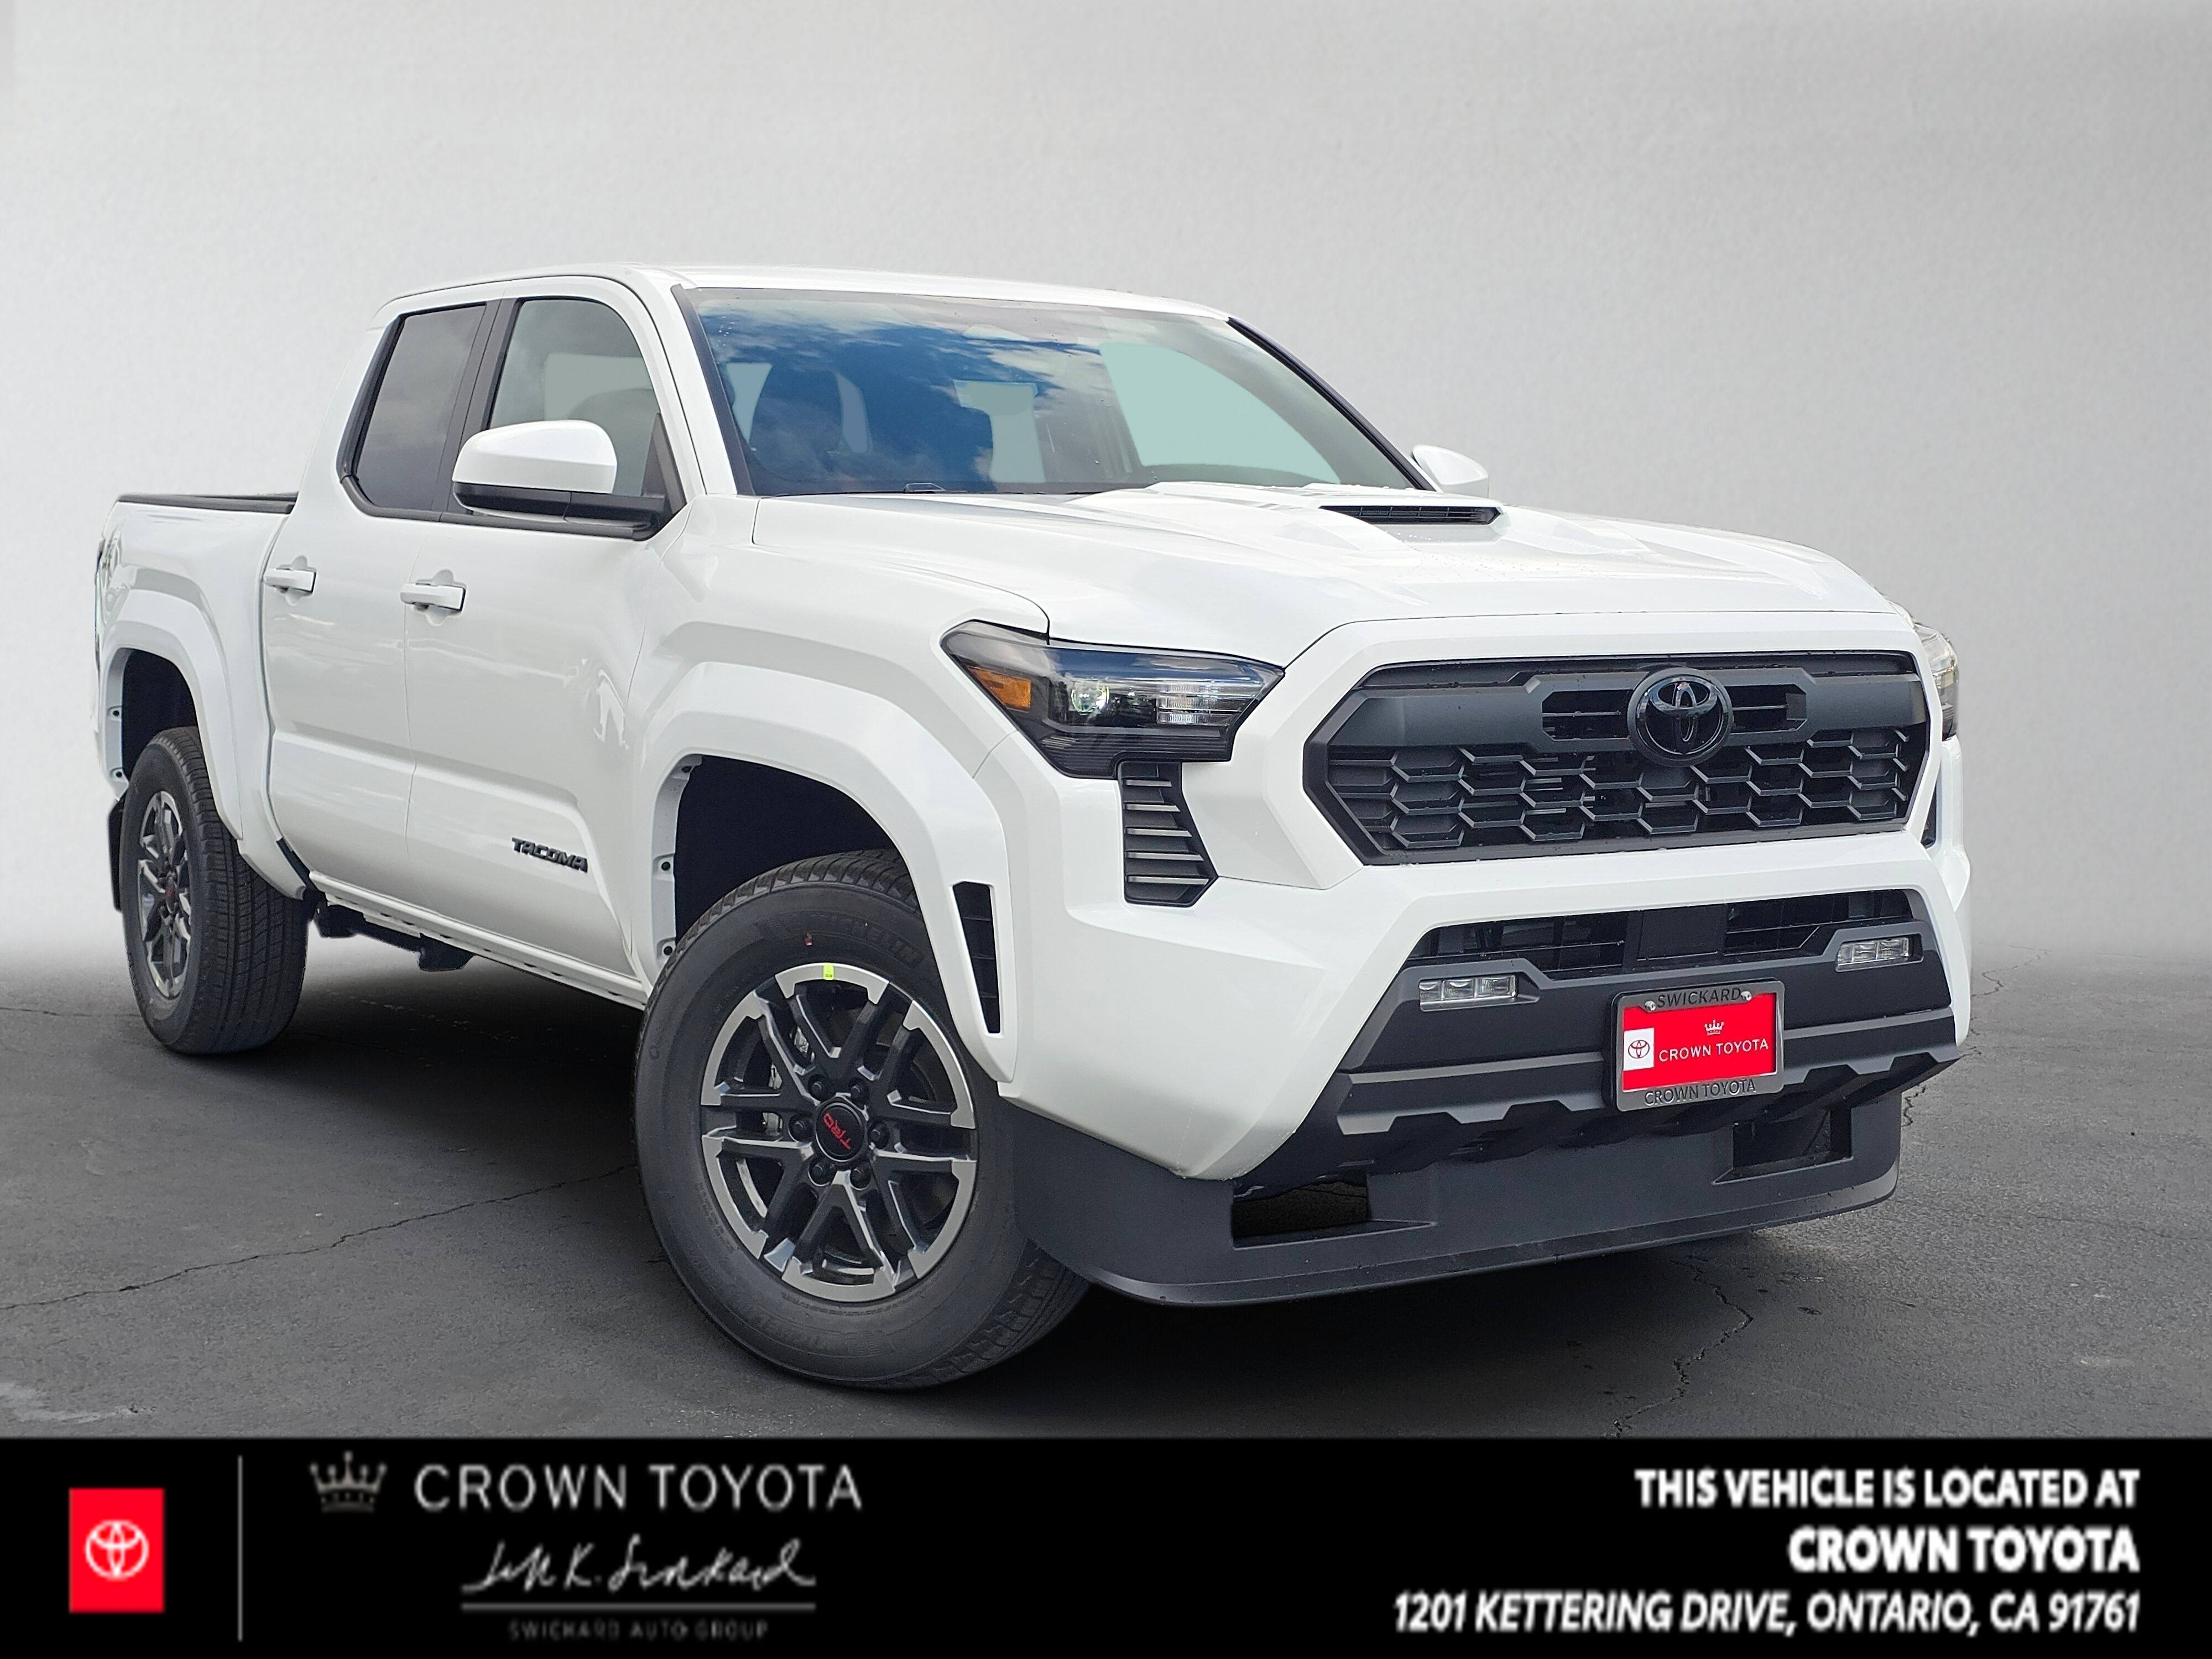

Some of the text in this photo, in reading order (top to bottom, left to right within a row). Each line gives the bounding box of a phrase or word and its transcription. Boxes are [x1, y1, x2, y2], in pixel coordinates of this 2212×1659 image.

[512, 837, 588, 873] TACOMA
[1657, 988, 1741, 1009] SWICKARD
[1658, 1038, 1769, 1063] CROWN TOYOTA
[1644, 1078, 1757, 1107] CROWN TOYOTA
[823, 1112, 851, 1150] TRD
